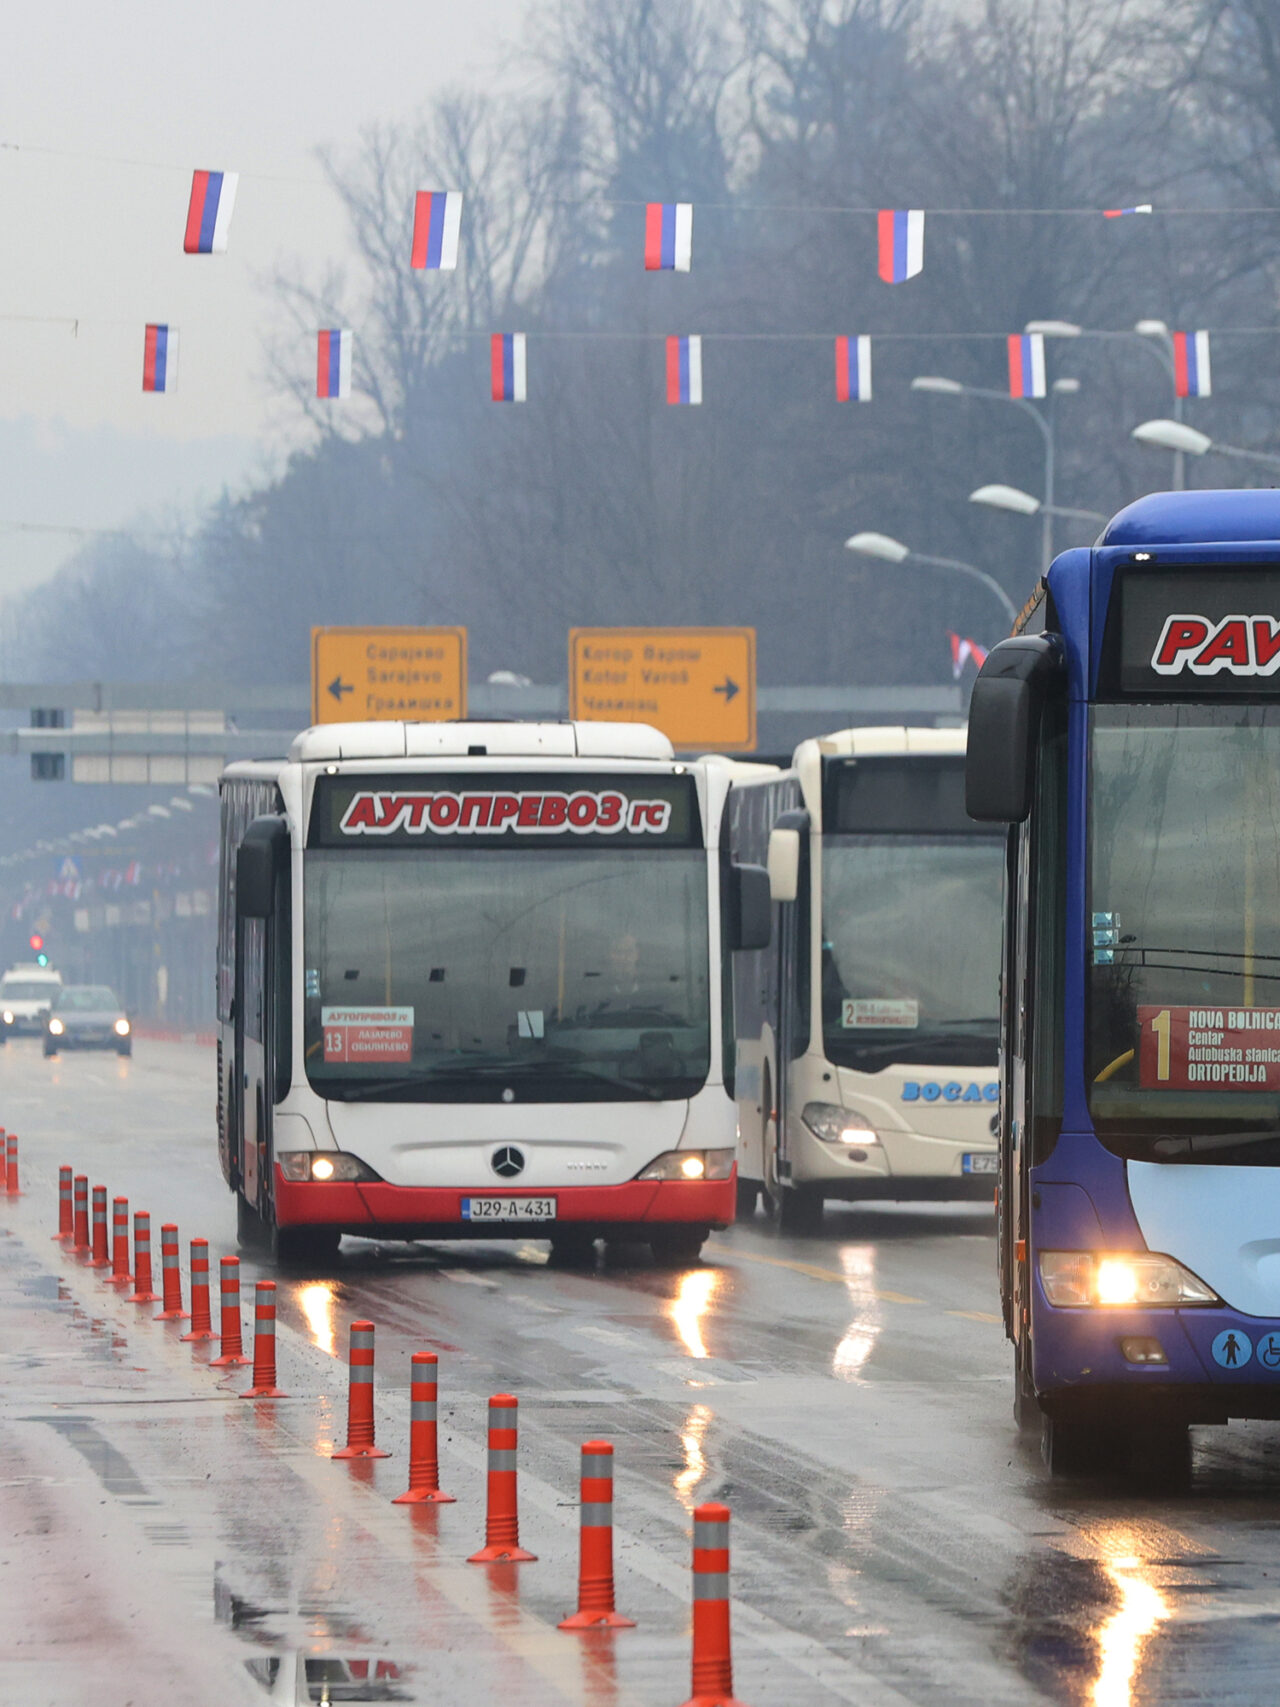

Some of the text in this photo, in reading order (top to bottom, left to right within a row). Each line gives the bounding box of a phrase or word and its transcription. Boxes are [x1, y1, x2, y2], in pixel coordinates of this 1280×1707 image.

[366, 644, 445, 662] Сарајево
[583, 645, 701, 663] Котор Варош
[367, 667, 442, 685] Sarajevo
[583, 668, 689, 684] Kotor Varoš
[366, 694, 453, 712] Градишка
[342, 793, 624, 831] АУТОПРЕВОЗ
[846, 1003, 855, 1025] 2
[1189, 1011, 1224, 1029] NOVA
[326, 1031, 343, 1053] 13
[358, 1031, 403, 1040] ЛАЗАРЕВО
[1188, 1031, 1224, 1046] Centar
[1152, 1010, 1171, 1081] 1
[1188, 1047, 1243, 1062] Autobuska
[1188, 1063, 1267, 1082] ORTOPEDIJA
[472, 1201, 553, 1216] J29-A-431
